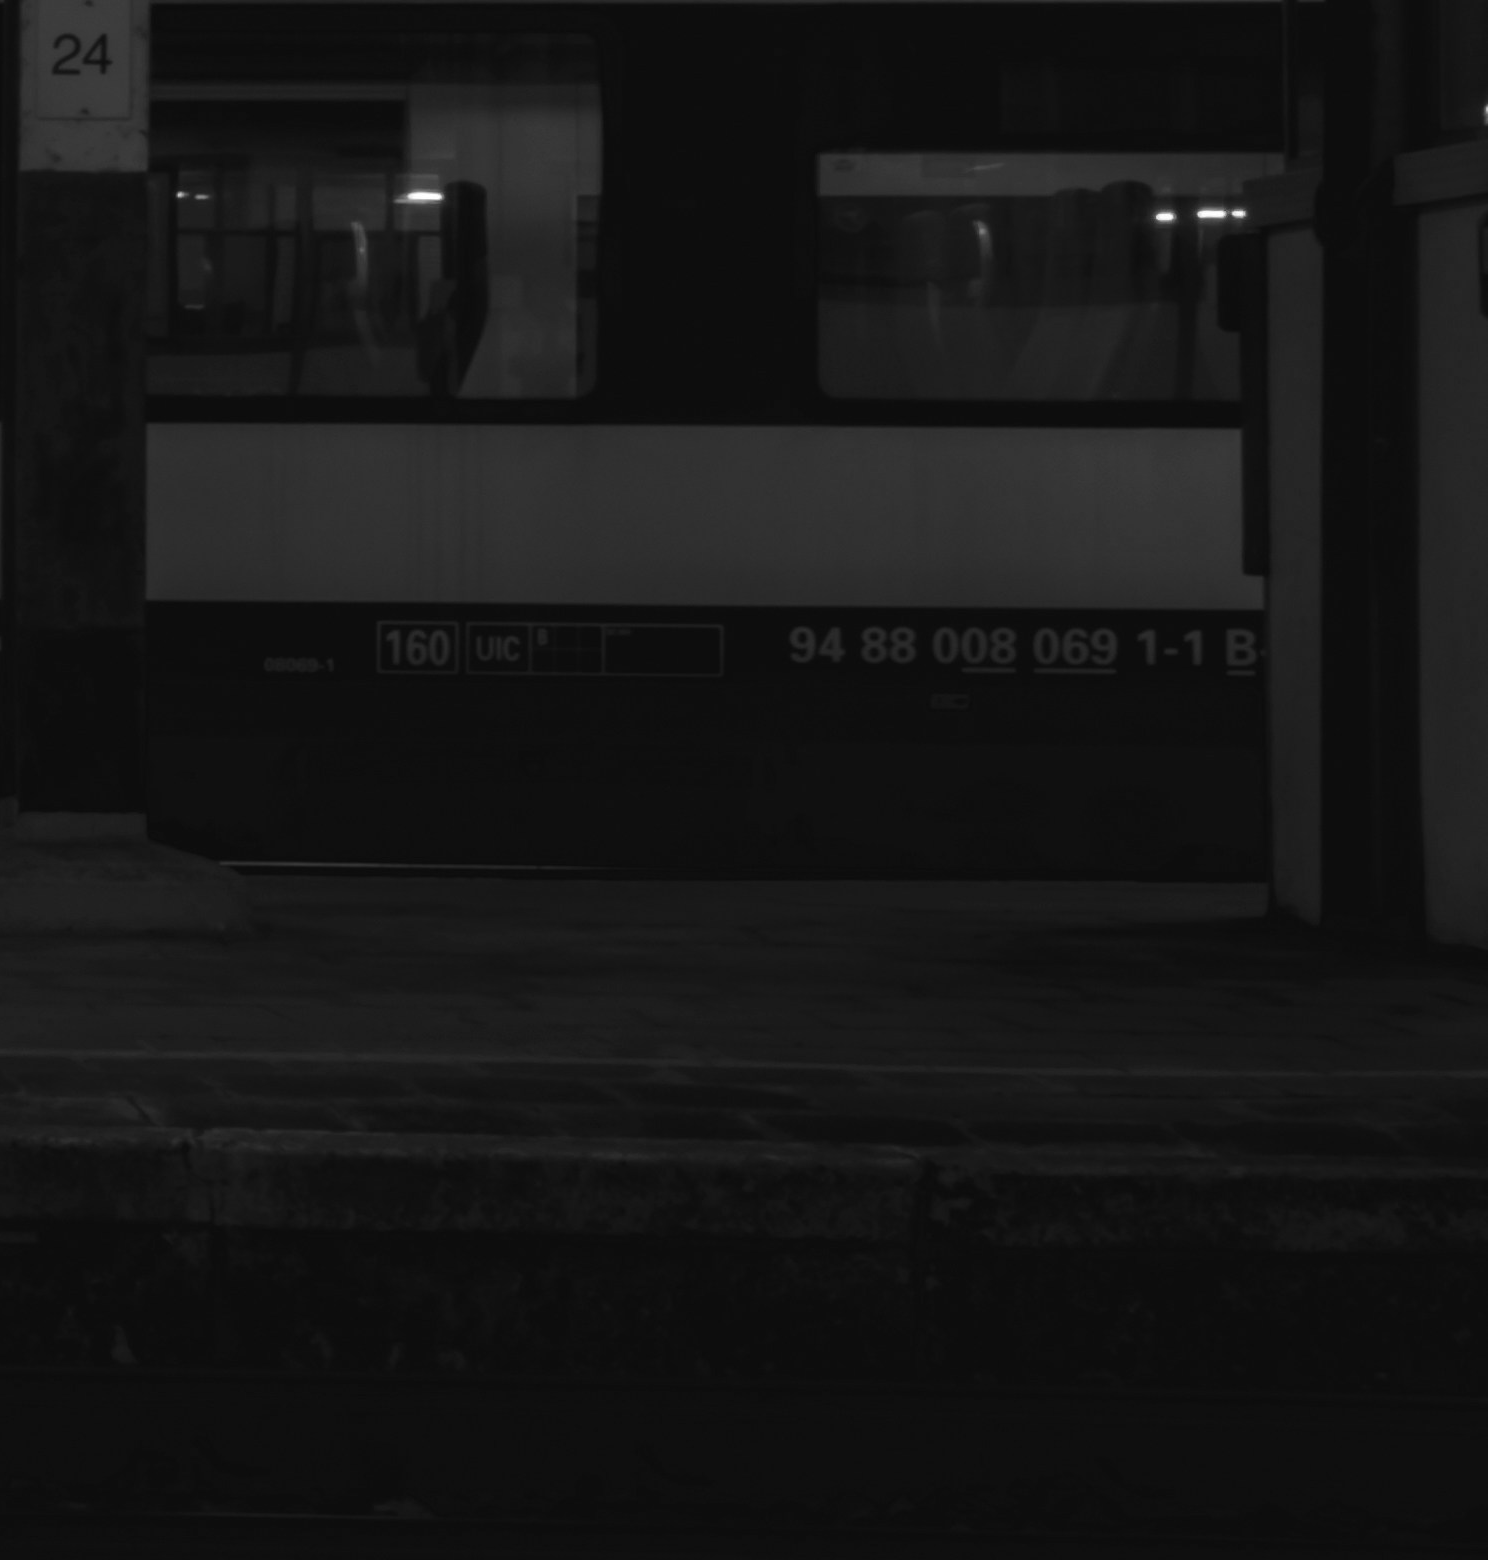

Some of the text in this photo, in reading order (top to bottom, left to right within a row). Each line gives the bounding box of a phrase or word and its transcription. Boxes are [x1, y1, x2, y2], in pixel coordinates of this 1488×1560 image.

[51, 33, 113, 75] 24
[385, 629, 451, 666] 160
[475, 635, 521, 663] UIC
[788, 626, 846, 664] 94
[860, 626, 917, 664] 88
[932, 626, 1017, 665] 008
[1033, 627, 1118, 666] 069
[1137, 628, 1204, 667] 1-1
